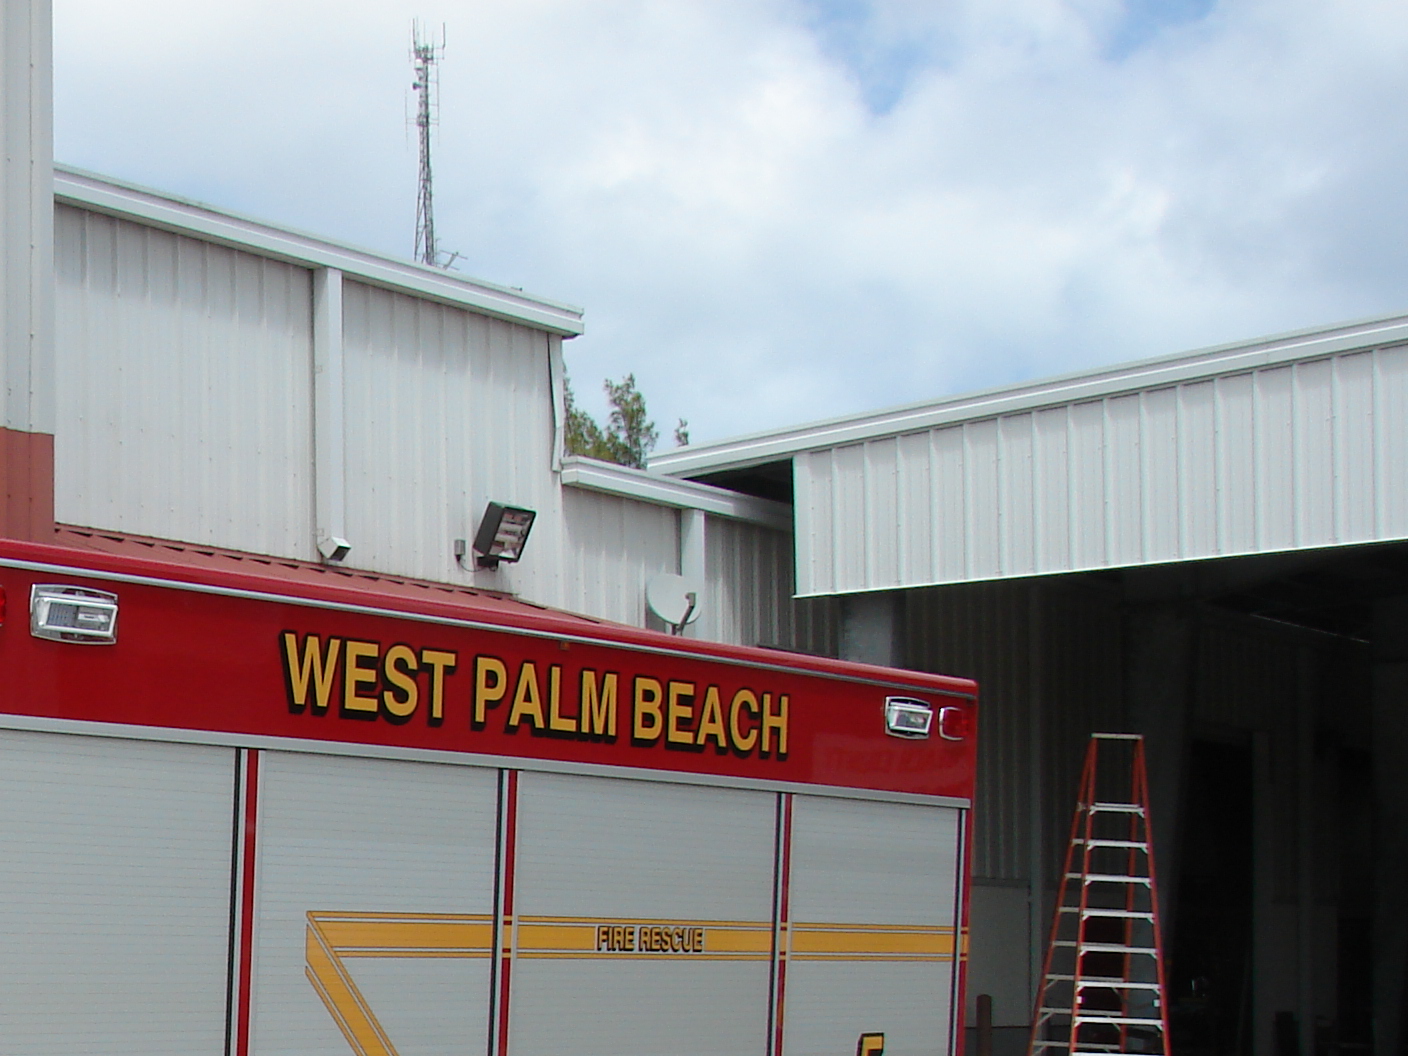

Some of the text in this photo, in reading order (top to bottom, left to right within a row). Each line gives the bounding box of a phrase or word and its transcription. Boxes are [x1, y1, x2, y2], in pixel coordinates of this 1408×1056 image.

[280, 631, 791, 759] WEST PALM BEACH
[597, 926, 703, 952] FIRE RESCUE
